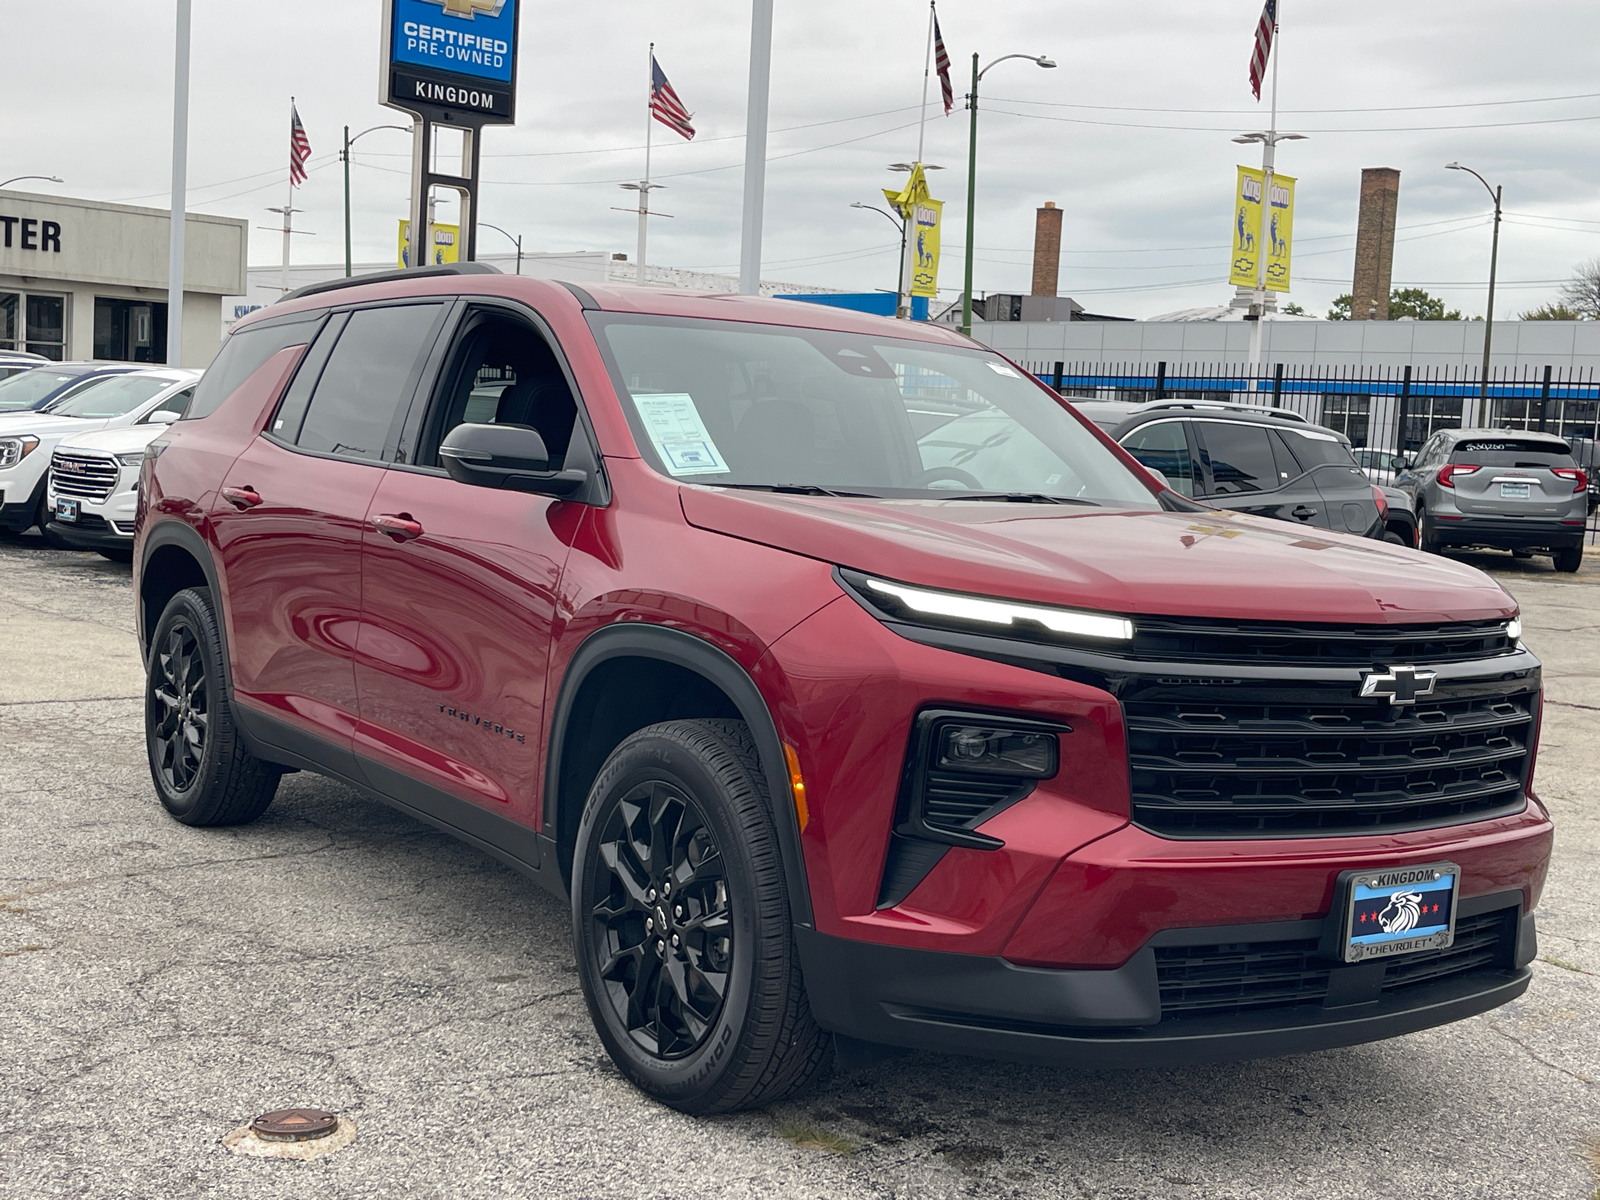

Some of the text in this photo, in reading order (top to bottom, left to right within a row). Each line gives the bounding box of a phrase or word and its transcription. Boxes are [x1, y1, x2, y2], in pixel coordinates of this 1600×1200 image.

[403, 21, 508, 54] CERTIFIED
[407, 37, 503, 68] PRE-OWNED
[415, 80, 493, 109] KINGDOM
[1241, 174, 1262, 204] King
[1270, 182, 1290, 209] dom
[917, 204, 937, 227] dom
[0, 215, 61, 252] TER
[434, 229, 454, 246] dom
[234, 304, 268, 318] KIN
[61, 461, 86, 474] GMC
[438, 703, 526, 745] TRAVERSE
[583, 747, 672, 828] CONTINENTAL
[1377, 868, 1435, 886] KINGDOM
[1369, 938, 1428, 955] CHEVROLET
